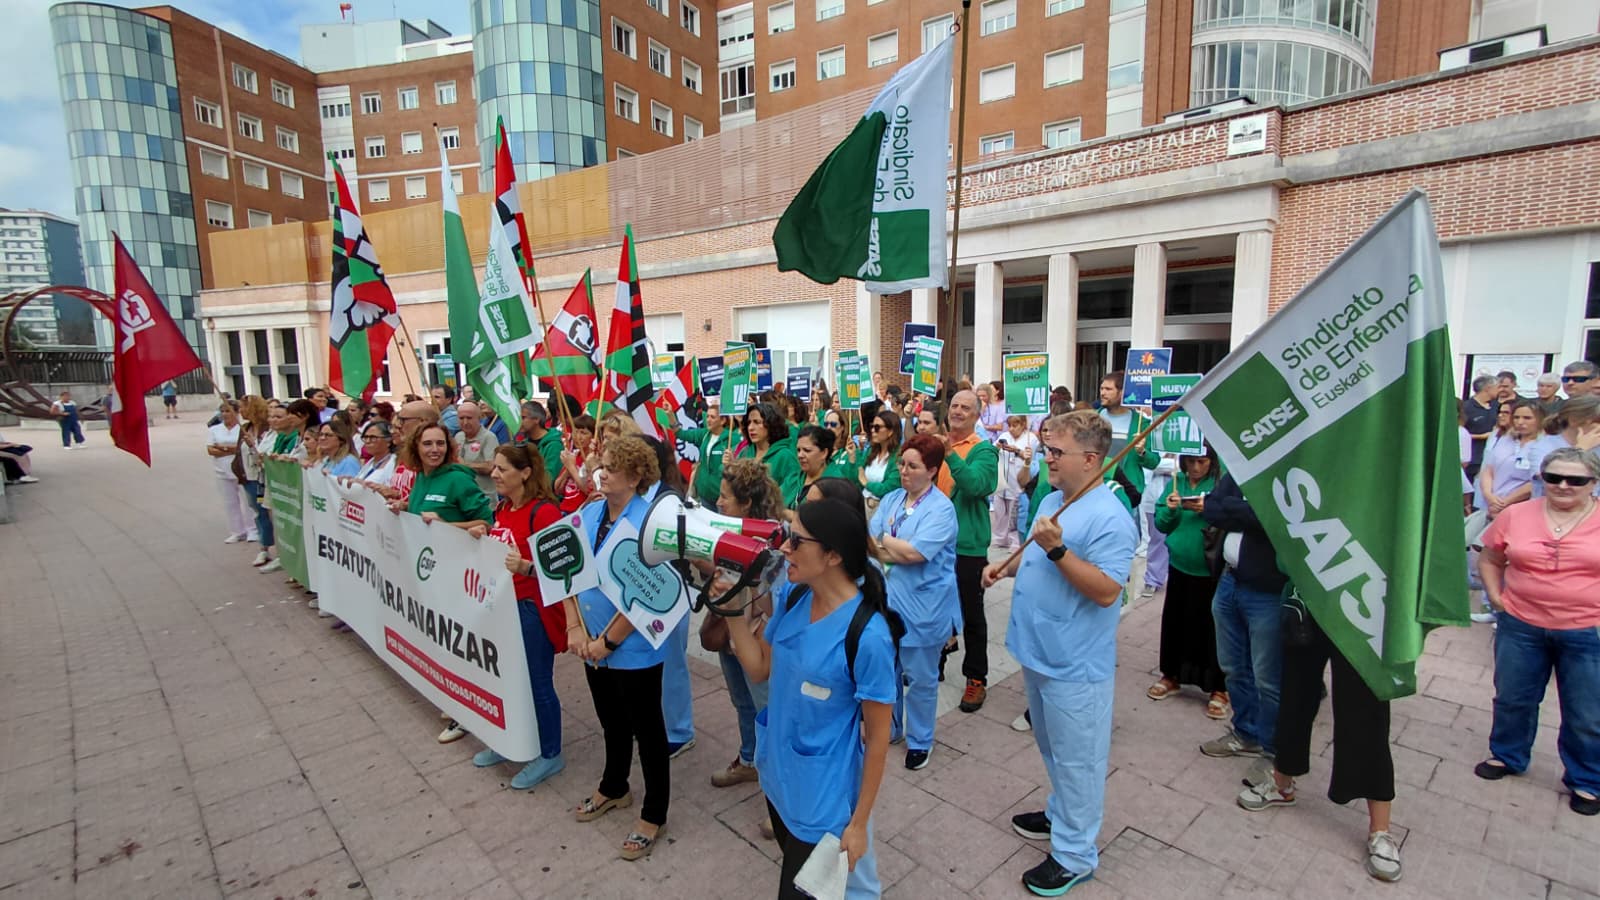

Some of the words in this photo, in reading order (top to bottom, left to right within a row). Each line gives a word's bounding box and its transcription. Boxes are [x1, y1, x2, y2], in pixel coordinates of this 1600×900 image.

[1109, 124, 1219, 160] OSPITALEA
[969, 169, 1090, 203] UNIVERSITARIO
[1097, 152, 1175, 179] CRUCES
[1281, 286, 1384, 370] Sindicato
[1013, 373, 1040, 383] DIGNO
[1127, 368, 1166, 376] LANALDIA
[1160, 384, 1192, 393] NUEVA
[1299, 362, 1330, 391] de
[1310, 359, 1376, 409] Euskadi
[1025, 387, 1046, 405] YA!
[1238, 397, 1301, 449] SATSE
[656, 530, 711, 554] SASE
[420, 556, 437, 572] CSIF
[626, 558, 661, 596] VOLUNTARIA
[1271, 467, 1388, 660] SATS
[622, 567, 655, 602] ANTICIPADA
[318, 534, 377, 591] ESTATUTO
[407, 596, 500, 678] AVANZAR
[445, 678, 500, 718] TODAS/TODOS
